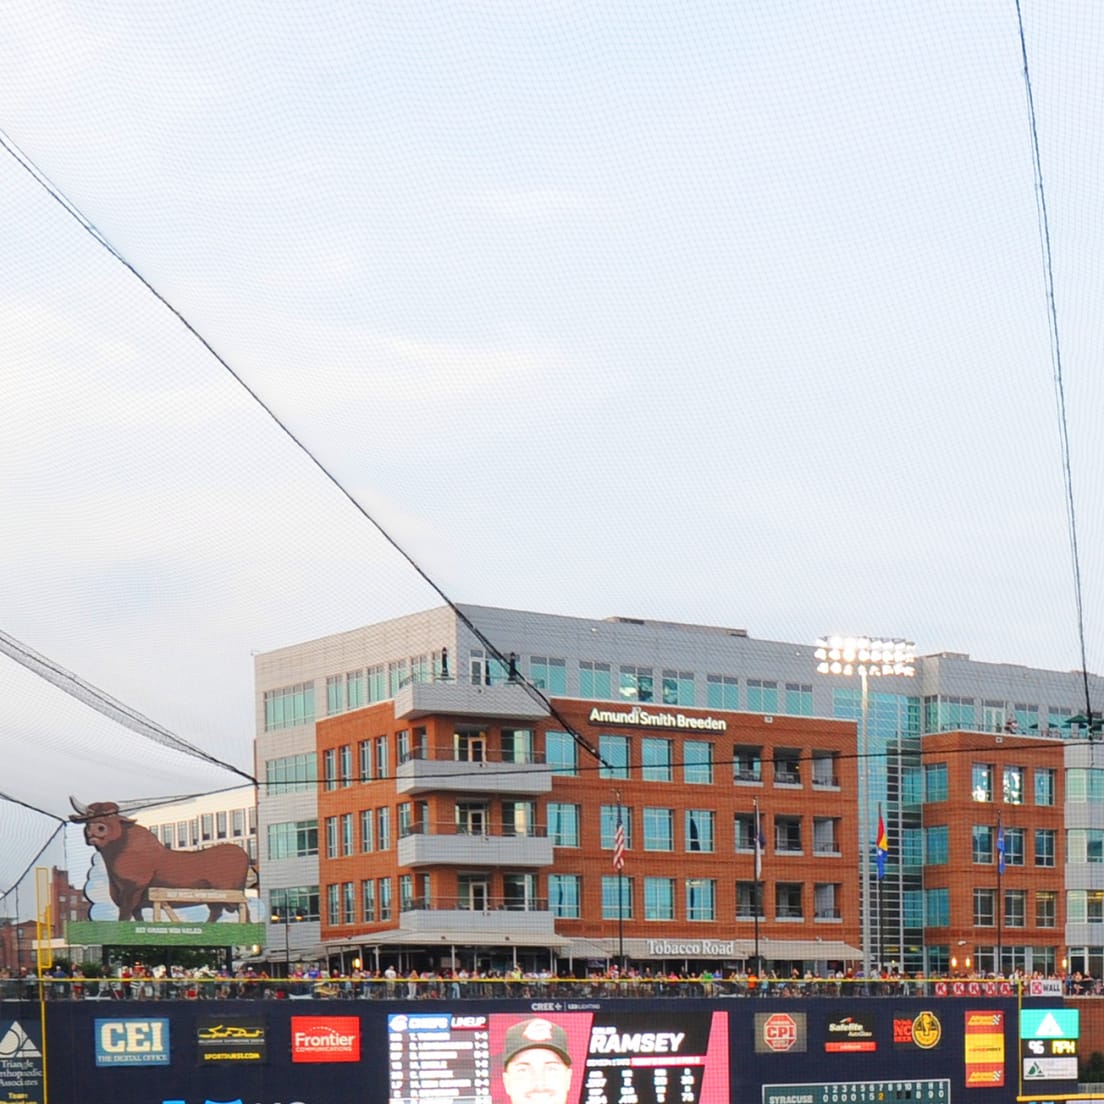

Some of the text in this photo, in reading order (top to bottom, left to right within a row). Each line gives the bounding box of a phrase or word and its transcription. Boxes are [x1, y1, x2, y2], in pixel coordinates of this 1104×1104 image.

[589, 706, 726, 730] Amundi Smith Breeden
[646, 940, 734, 954] Tobacco Road
[1043, 984, 1060, 992] WALL
[768, 1027, 794, 1038] CPI
[829, 1023, 863, 1032] Safelite
[894, 1026, 912, 1036] NC
[101, 1022, 163, 1053] CEI
[295, 1032, 356, 1046] Frontier
[590, 1032, 685, 1053] RAMSEY
[1052, 1040, 1075, 1054] MPH
[1, 1060, 34, 1070] Triangle
[769, 1095, 813, 1104] SYRACUSE
[823, 1094, 828, 1102] 0
[841, 1094, 847, 1102] 0
[851, 1093, 856, 1101] 0
